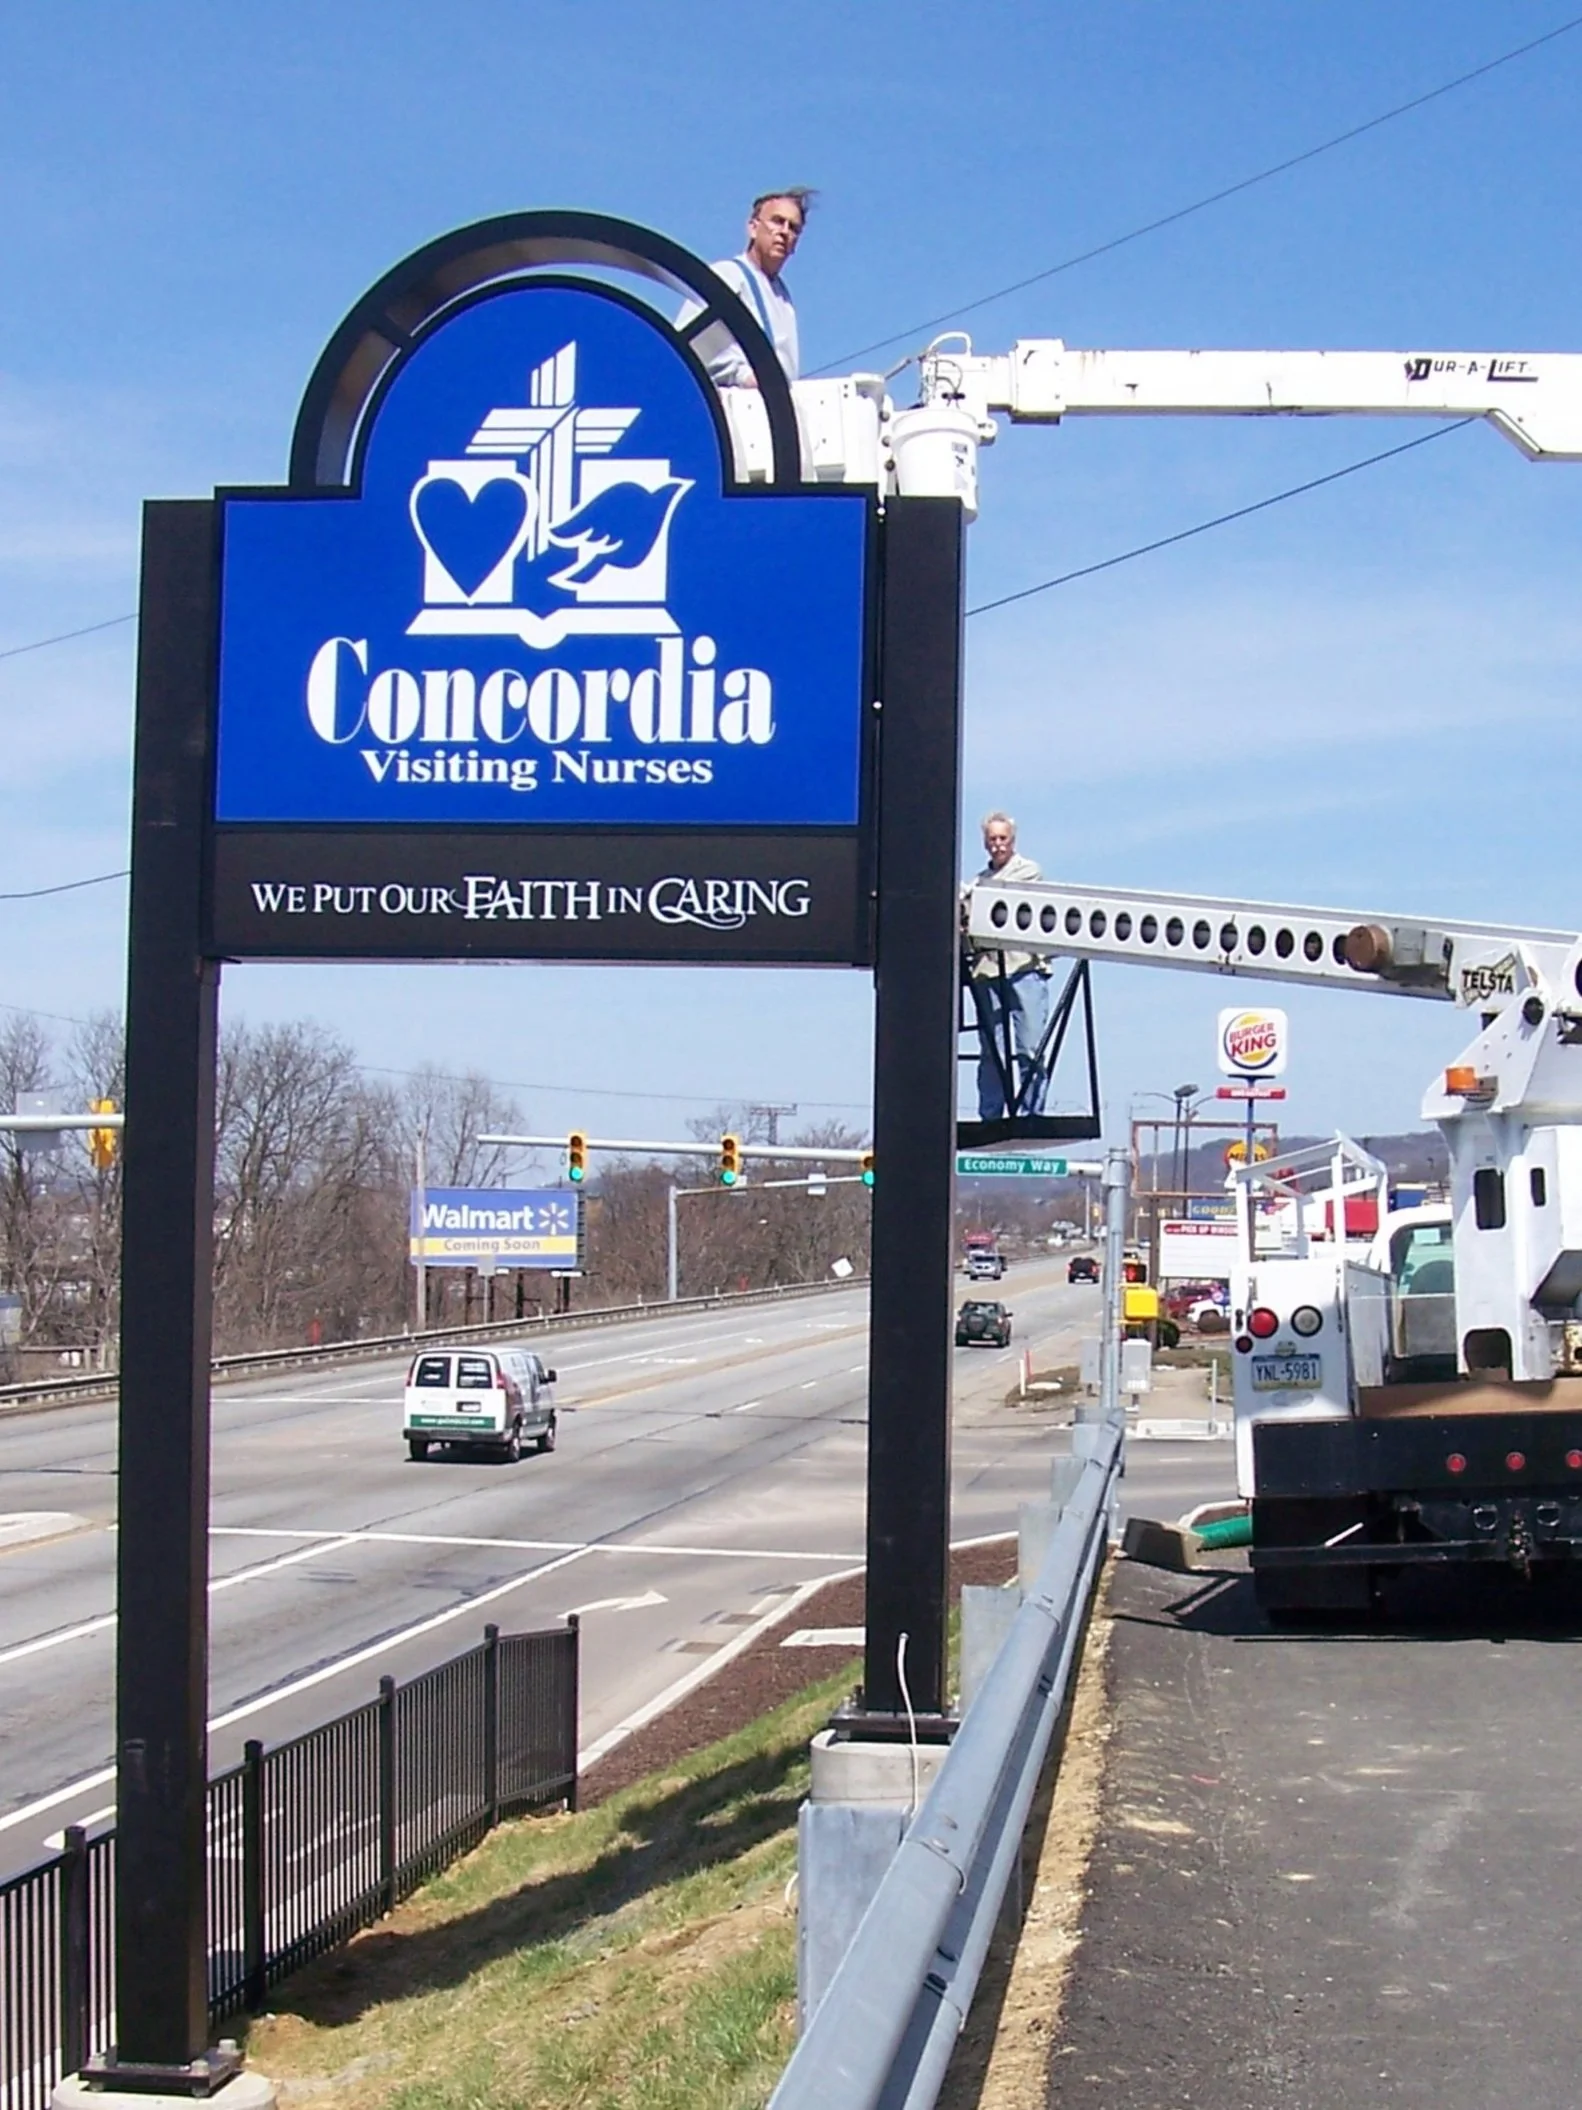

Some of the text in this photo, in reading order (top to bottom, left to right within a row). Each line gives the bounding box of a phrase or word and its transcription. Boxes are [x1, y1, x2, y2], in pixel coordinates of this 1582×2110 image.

[307, 635, 776, 745] Concordia
[361, 750, 713, 791] Visiting Nurses
[251, 875, 811, 930] WE PUT OUR FAITH IN CARING
[1462, 969, 1514, 993] TELSTA
[1229, 1022, 1275, 1043] BURGER
[1231, 1033, 1276, 1057] KING
[964, 1158, 1061, 1173] Economy Way
[422, 1203, 534, 1231] Walmart
[444, 1238, 541, 1254] Coming Soon
